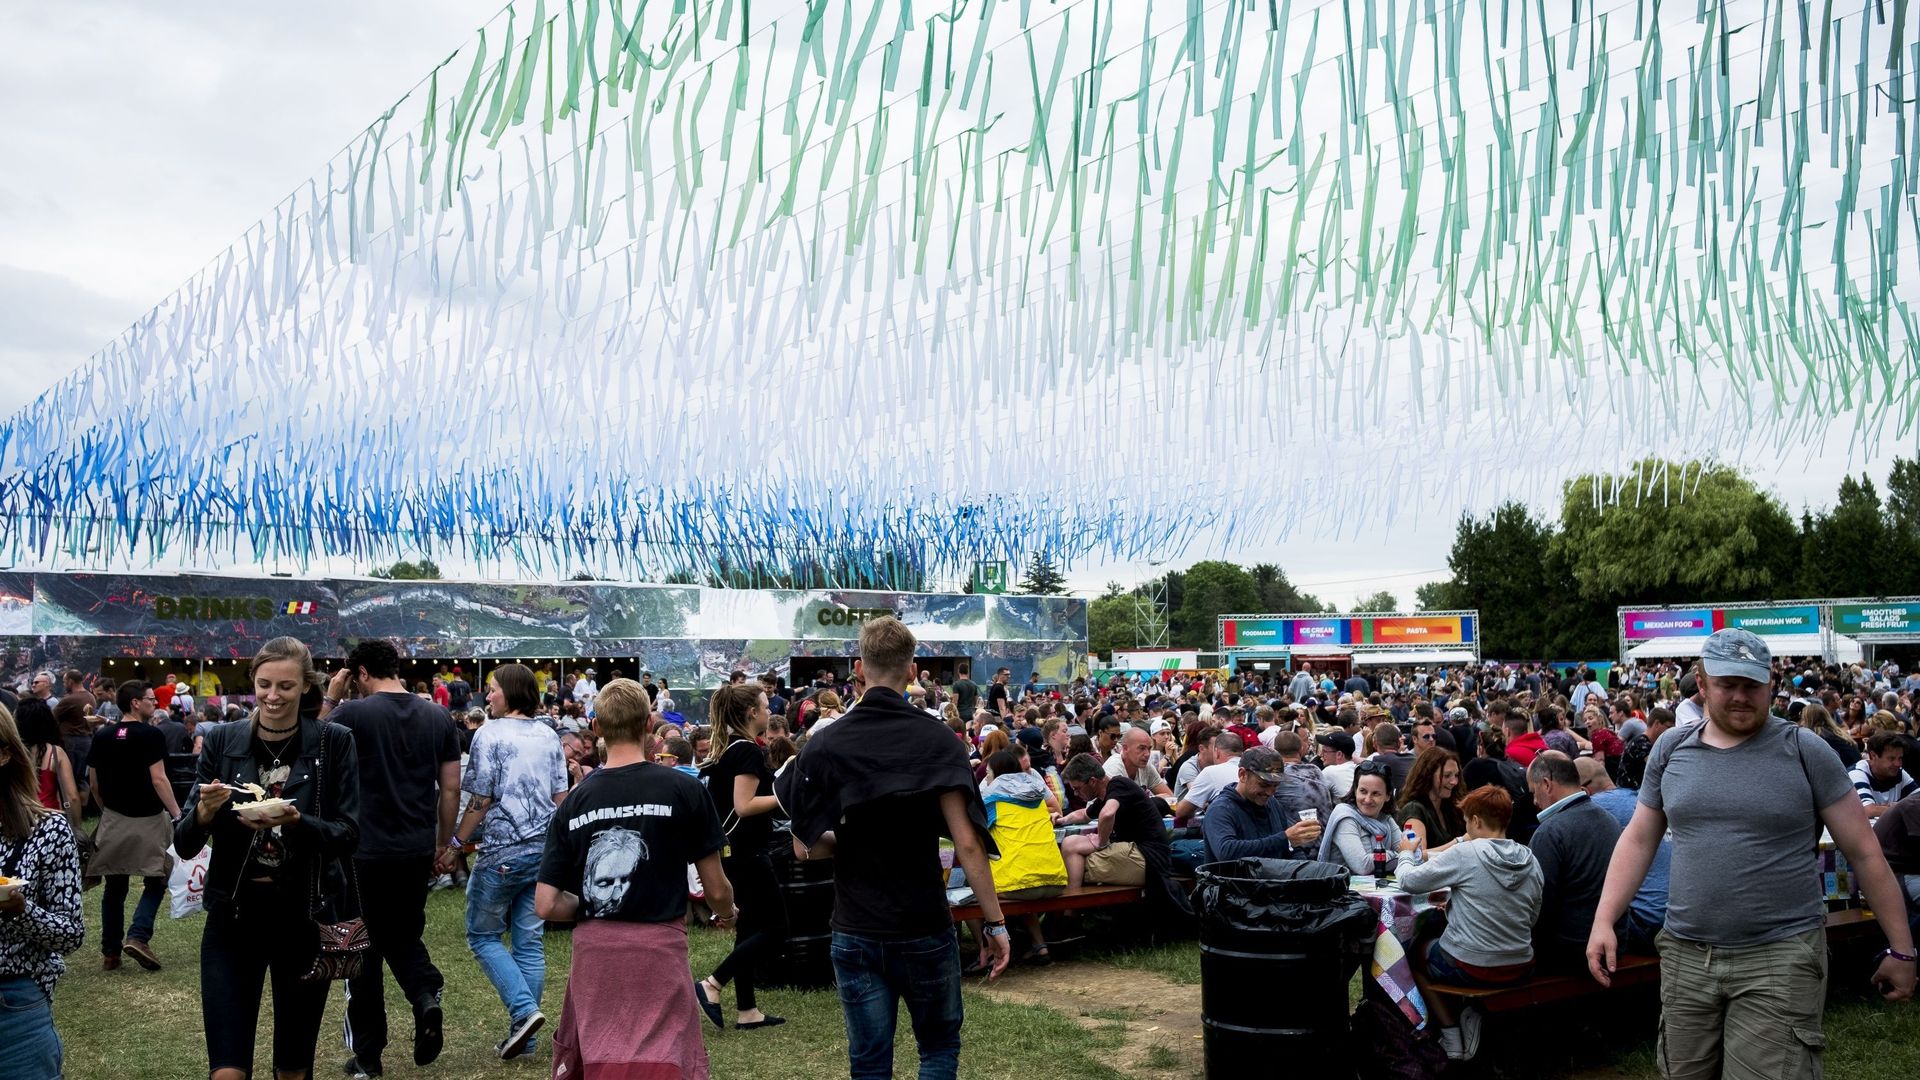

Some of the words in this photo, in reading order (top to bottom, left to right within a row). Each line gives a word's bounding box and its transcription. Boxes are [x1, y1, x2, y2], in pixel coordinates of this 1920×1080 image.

[156, 597, 273, 620] DRINKS
[1862, 608, 1907, 616] SMOOTHIES
[1644, 621, 1674, 629] MEXICAN
[1674, 620, 1693, 628] FOOD
[1740, 618, 1784, 626] VEGETARIAN
[1785, 617, 1802, 625] WOK
[1886, 620, 1909, 628] FRUIT
[1406, 627, 1428, 635] PASTA
[569, 804, 672, 831] RAMMSTEIN
